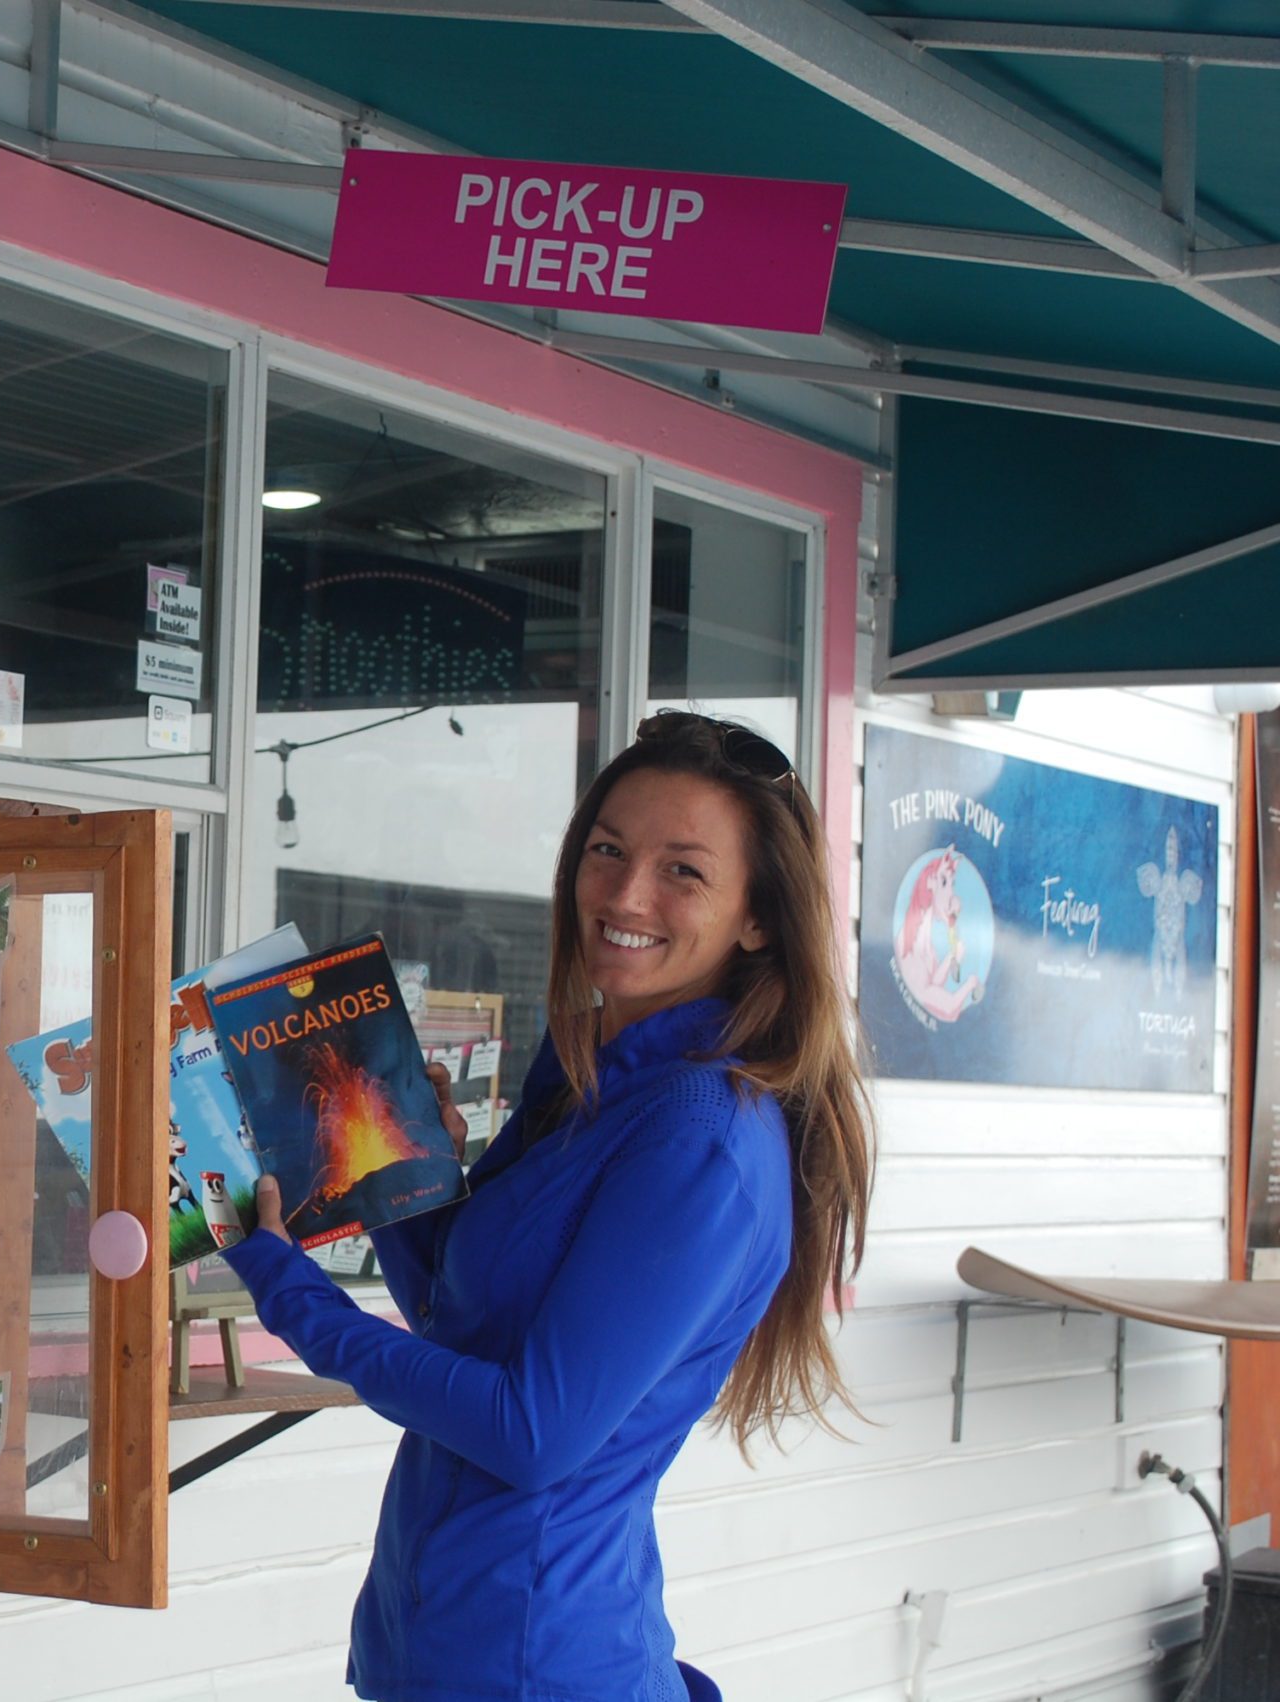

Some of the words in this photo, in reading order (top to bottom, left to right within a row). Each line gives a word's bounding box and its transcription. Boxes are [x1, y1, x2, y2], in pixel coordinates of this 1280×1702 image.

[454, 173, 705, 241] PICK-UP
[483, 235, 653, 299] HERE
[160, 583, 179, 599] ATM
[160, 600, 199, 621] Available
[159, 616, 190, 636] Inside!
[145, 654, 156, 668] $5
[889, 790, 920, 830] THE
[924, 789, 960, 823] PINK
[965, 797, 1005, 848] PONY
[282, 961, 326, 982] SCIENCE
[229, 983, 392, 1056] VOLCANOES
[1138, 1011, 1197, 1041] TORTUGA
[176, 1046, 212, 1069] Farm
[301, 1224, 360, 1249] SCHOLASTIC
